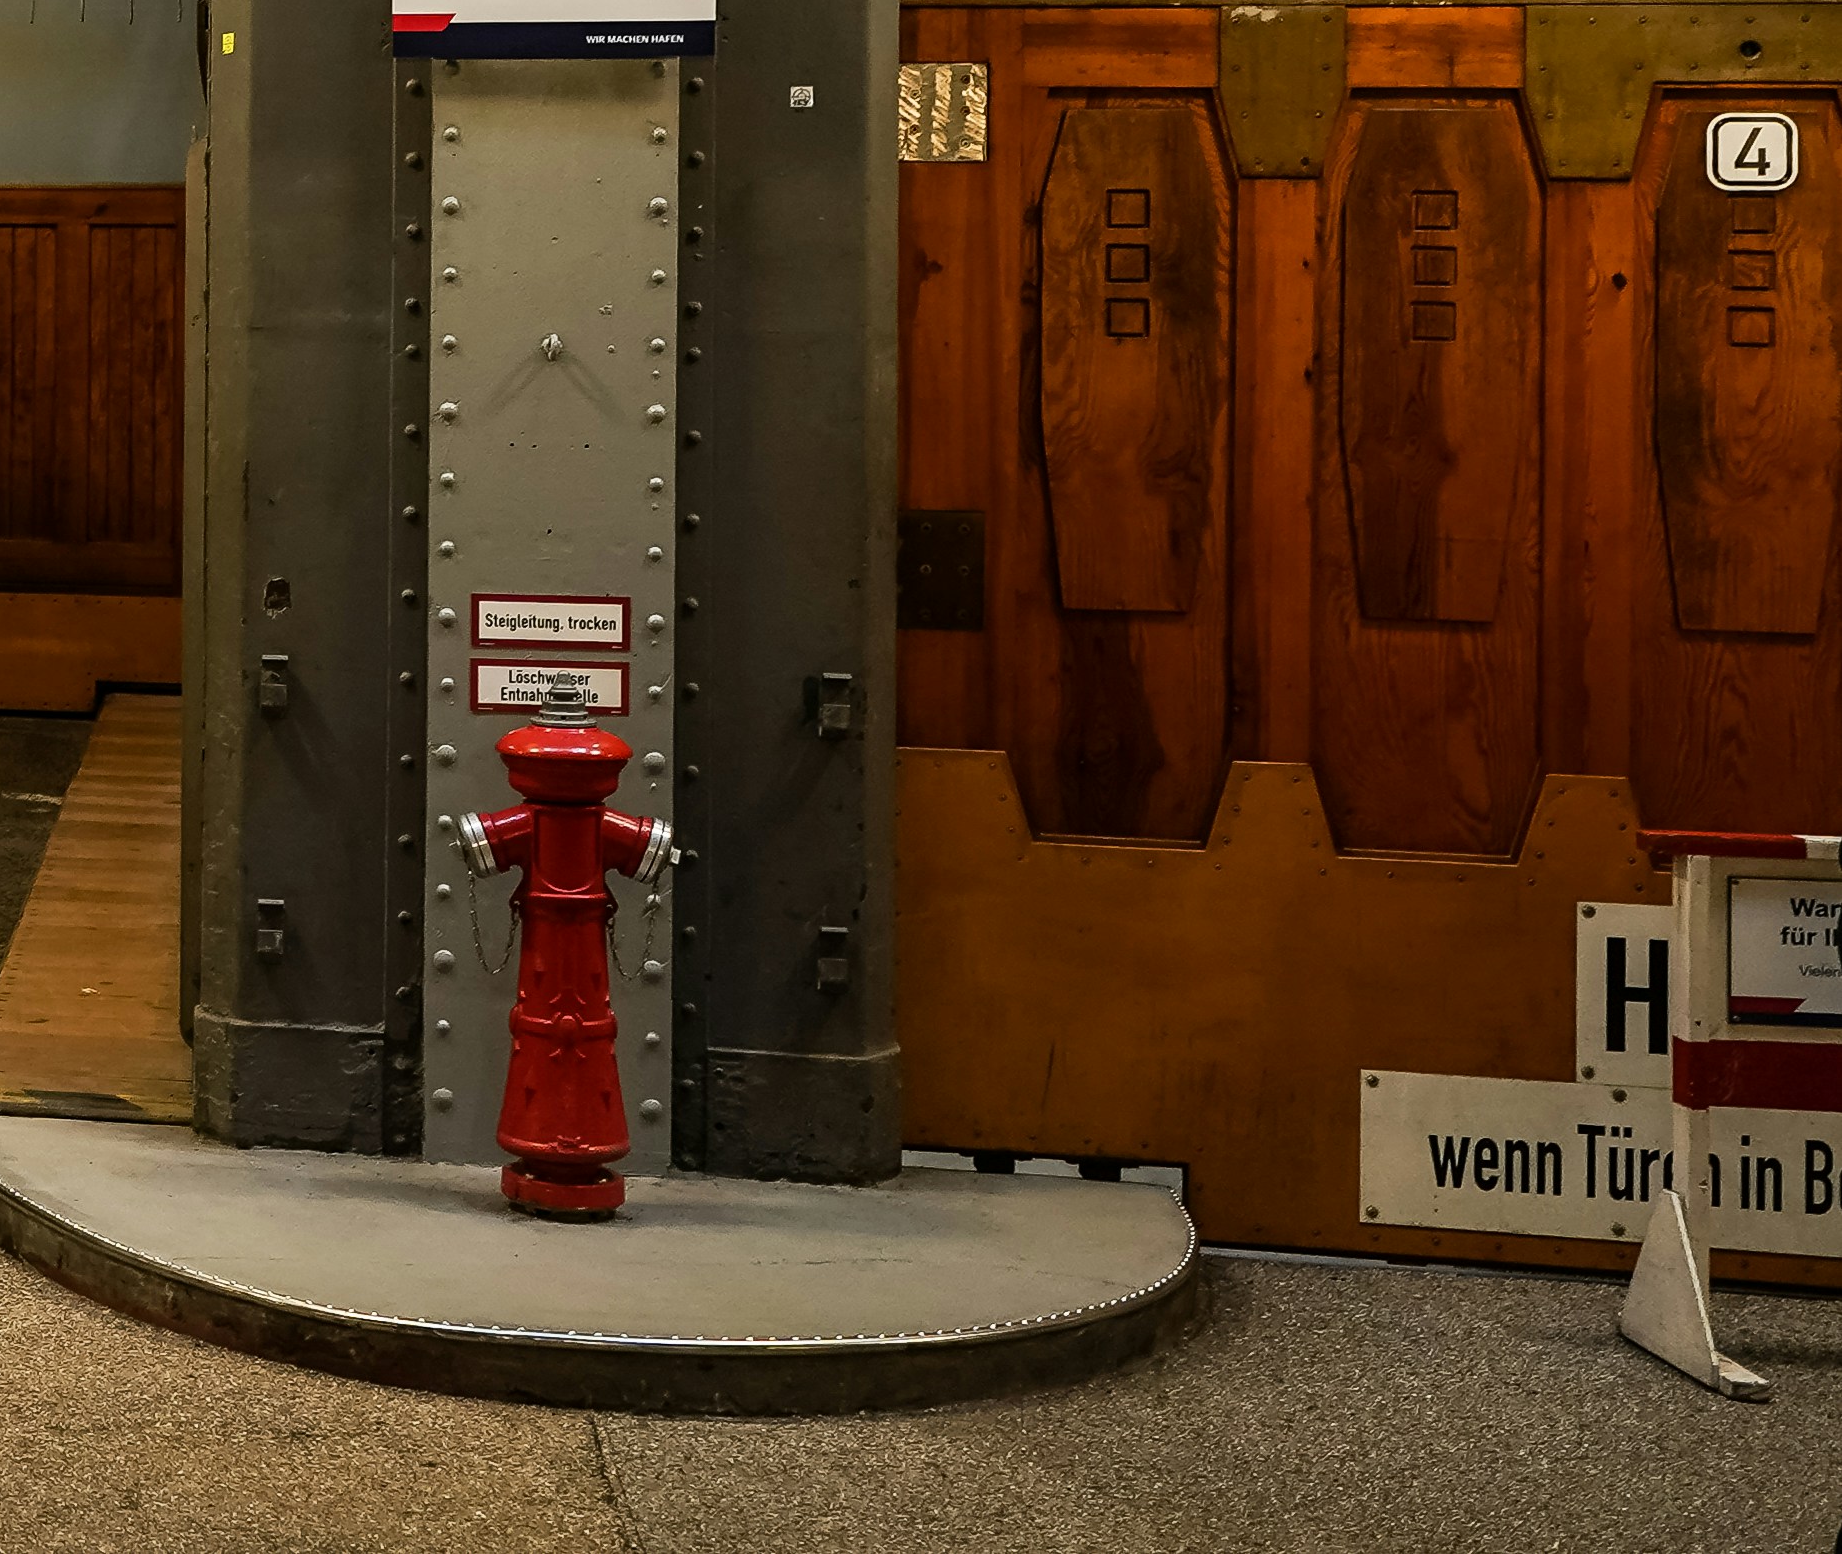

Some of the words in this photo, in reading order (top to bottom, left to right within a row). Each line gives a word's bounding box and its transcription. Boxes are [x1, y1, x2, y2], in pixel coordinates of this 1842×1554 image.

[585, 34, 606, 44] WIR
[607, 34, 650, 44] MACHEN
[651, 34, 685, 44] HAFEN
[1734, 127, 1771, 176] 4
[568, 615, 617, 631] trocken
[508, 669, 591, 686] Löschwser
[1780, 926, 1817, 946] für
[1428, 1135, 1562, 1197] wenn
[1741, 1134, 1783, 1213] in
